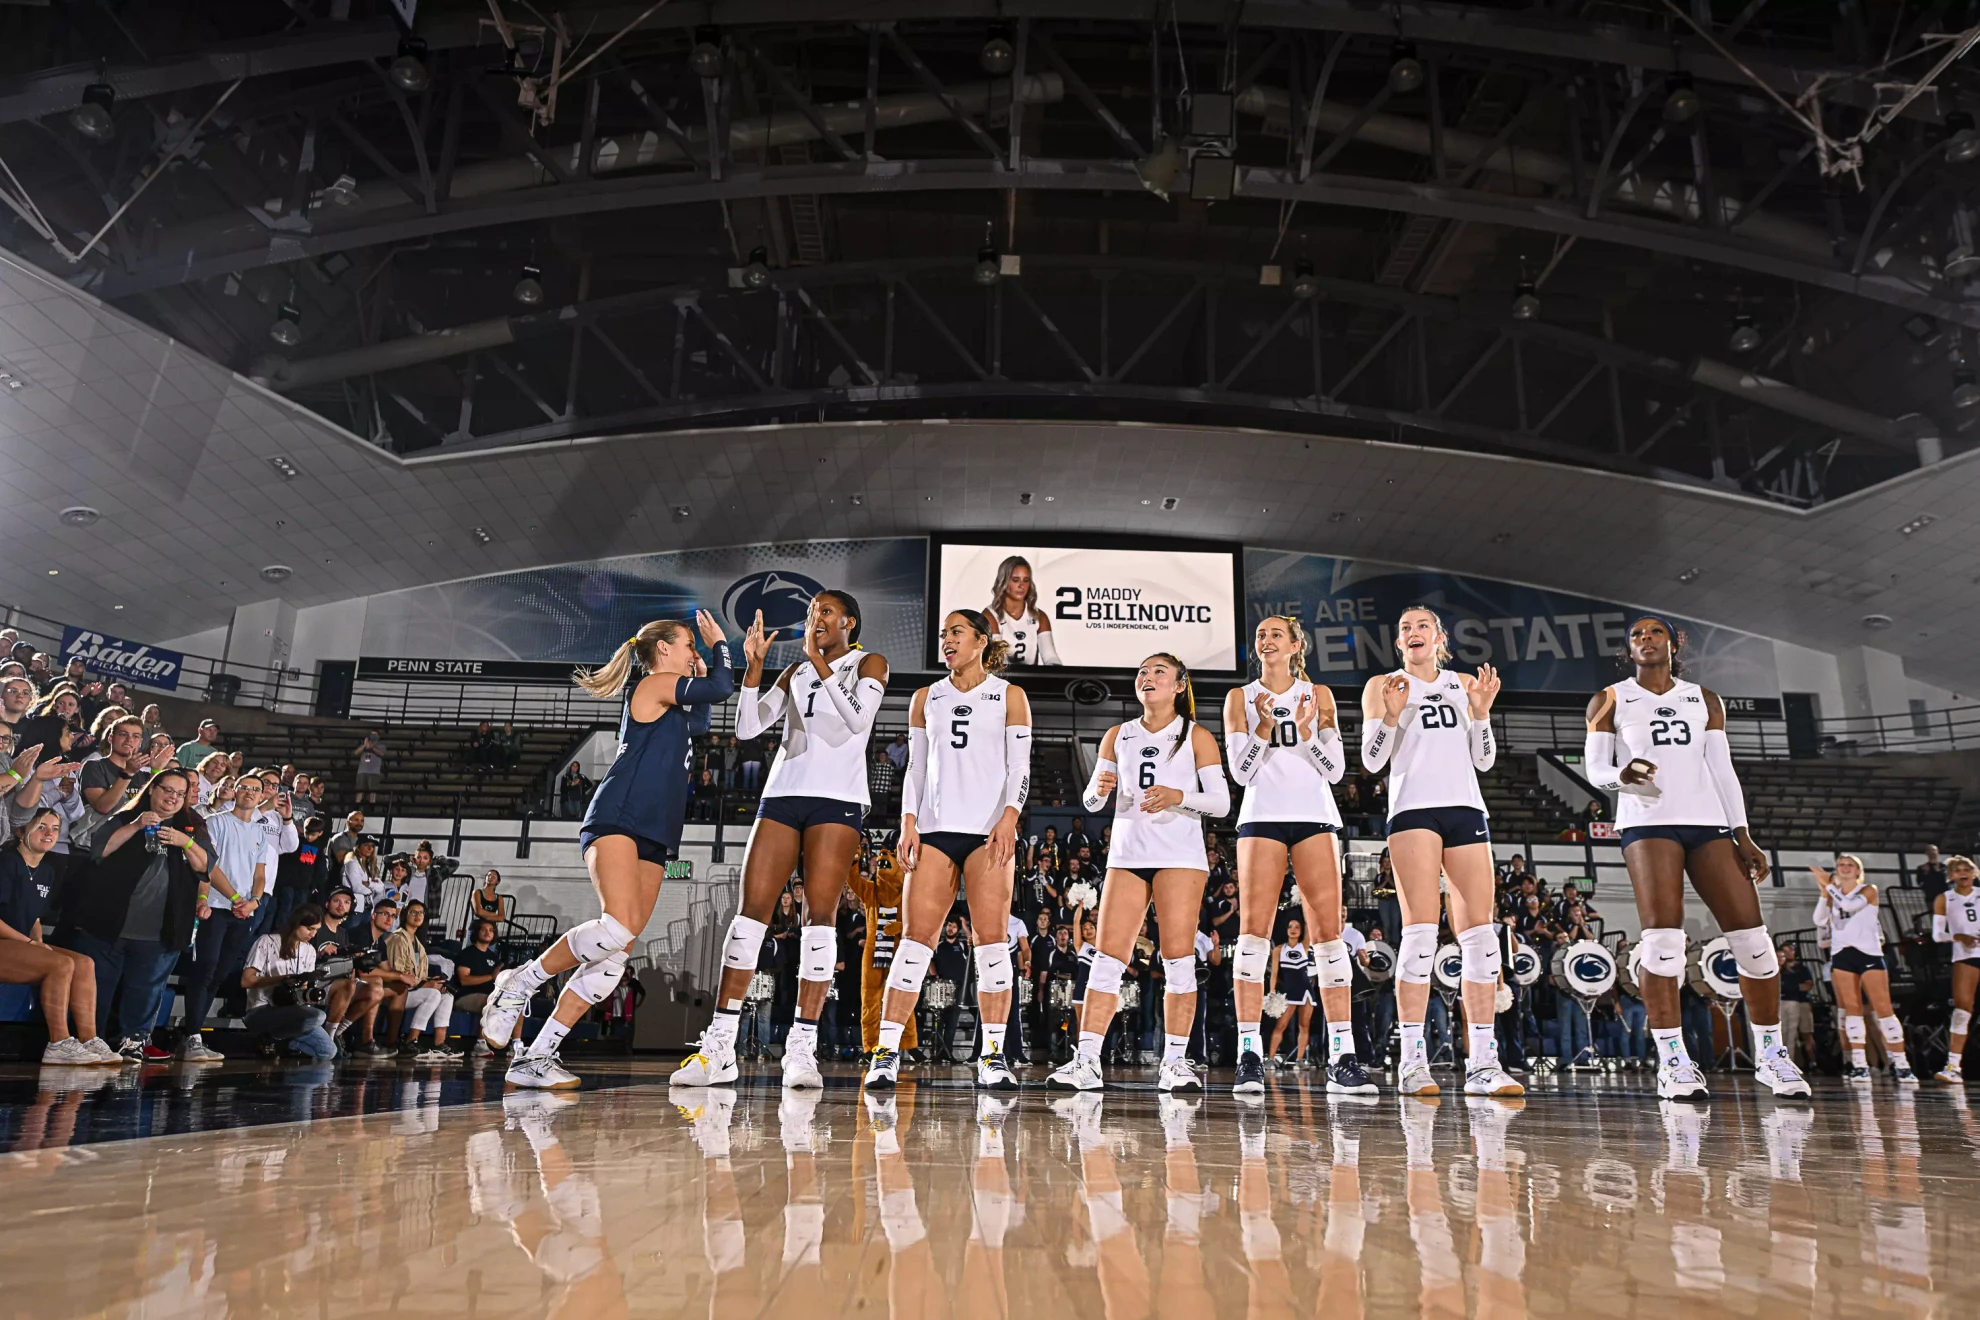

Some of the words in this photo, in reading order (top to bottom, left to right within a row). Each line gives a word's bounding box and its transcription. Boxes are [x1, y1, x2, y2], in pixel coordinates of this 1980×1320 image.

[1055, 586, 1082, 620] 2
[1086, 587, 1142, 601] MADDY
[1087, 602, 1212, 624] BILINOVIC
[1254, 601, 1305, 624] WE
[1315, 597, 1378, 623] ARE
[1107, 623, 1158, 631] INDEPENDENCE,
[1453, 612, 1626, 665] STATE
[66, 631, 177, 677] Baden
[1014, 642, 1027, 662] 2
[85, 657, 127, 673] FFICIAL
[131, 669, 160, 681] BALL
[387, 659, 430, 672] PENN
[434, 661, 483, 674] STATE
[803, 691, 817, 719] 1
[837, 681, 848, 696] WE
[847, 695, 862, 714] ARE
[1724, 698, 1756, 711] TATE
[1418, 704, 1458, 729] 20
[950, 719, 970, 750] 5
[1268, 720, 1298, 749] 10
[1369, 745, 1380, 758] WE
[1376, 730, 1387, 748] ARE
[1482, 727, 1489, 741] WE
[1649, 719, 1692, 746] 23
[1240, 759, 1250, 773] WE
[1247, 743, 1261, 761] ARE
[1310, 744, 1321, 759] WE
[1319, 756, 1335, 772] ARE
[1483, 741, 1491, 757] ARE
[1138, 761, 1156, 790] 6
[1017, 790, 1027, 805] WE
[1965, 908, 1978, 922] 8
